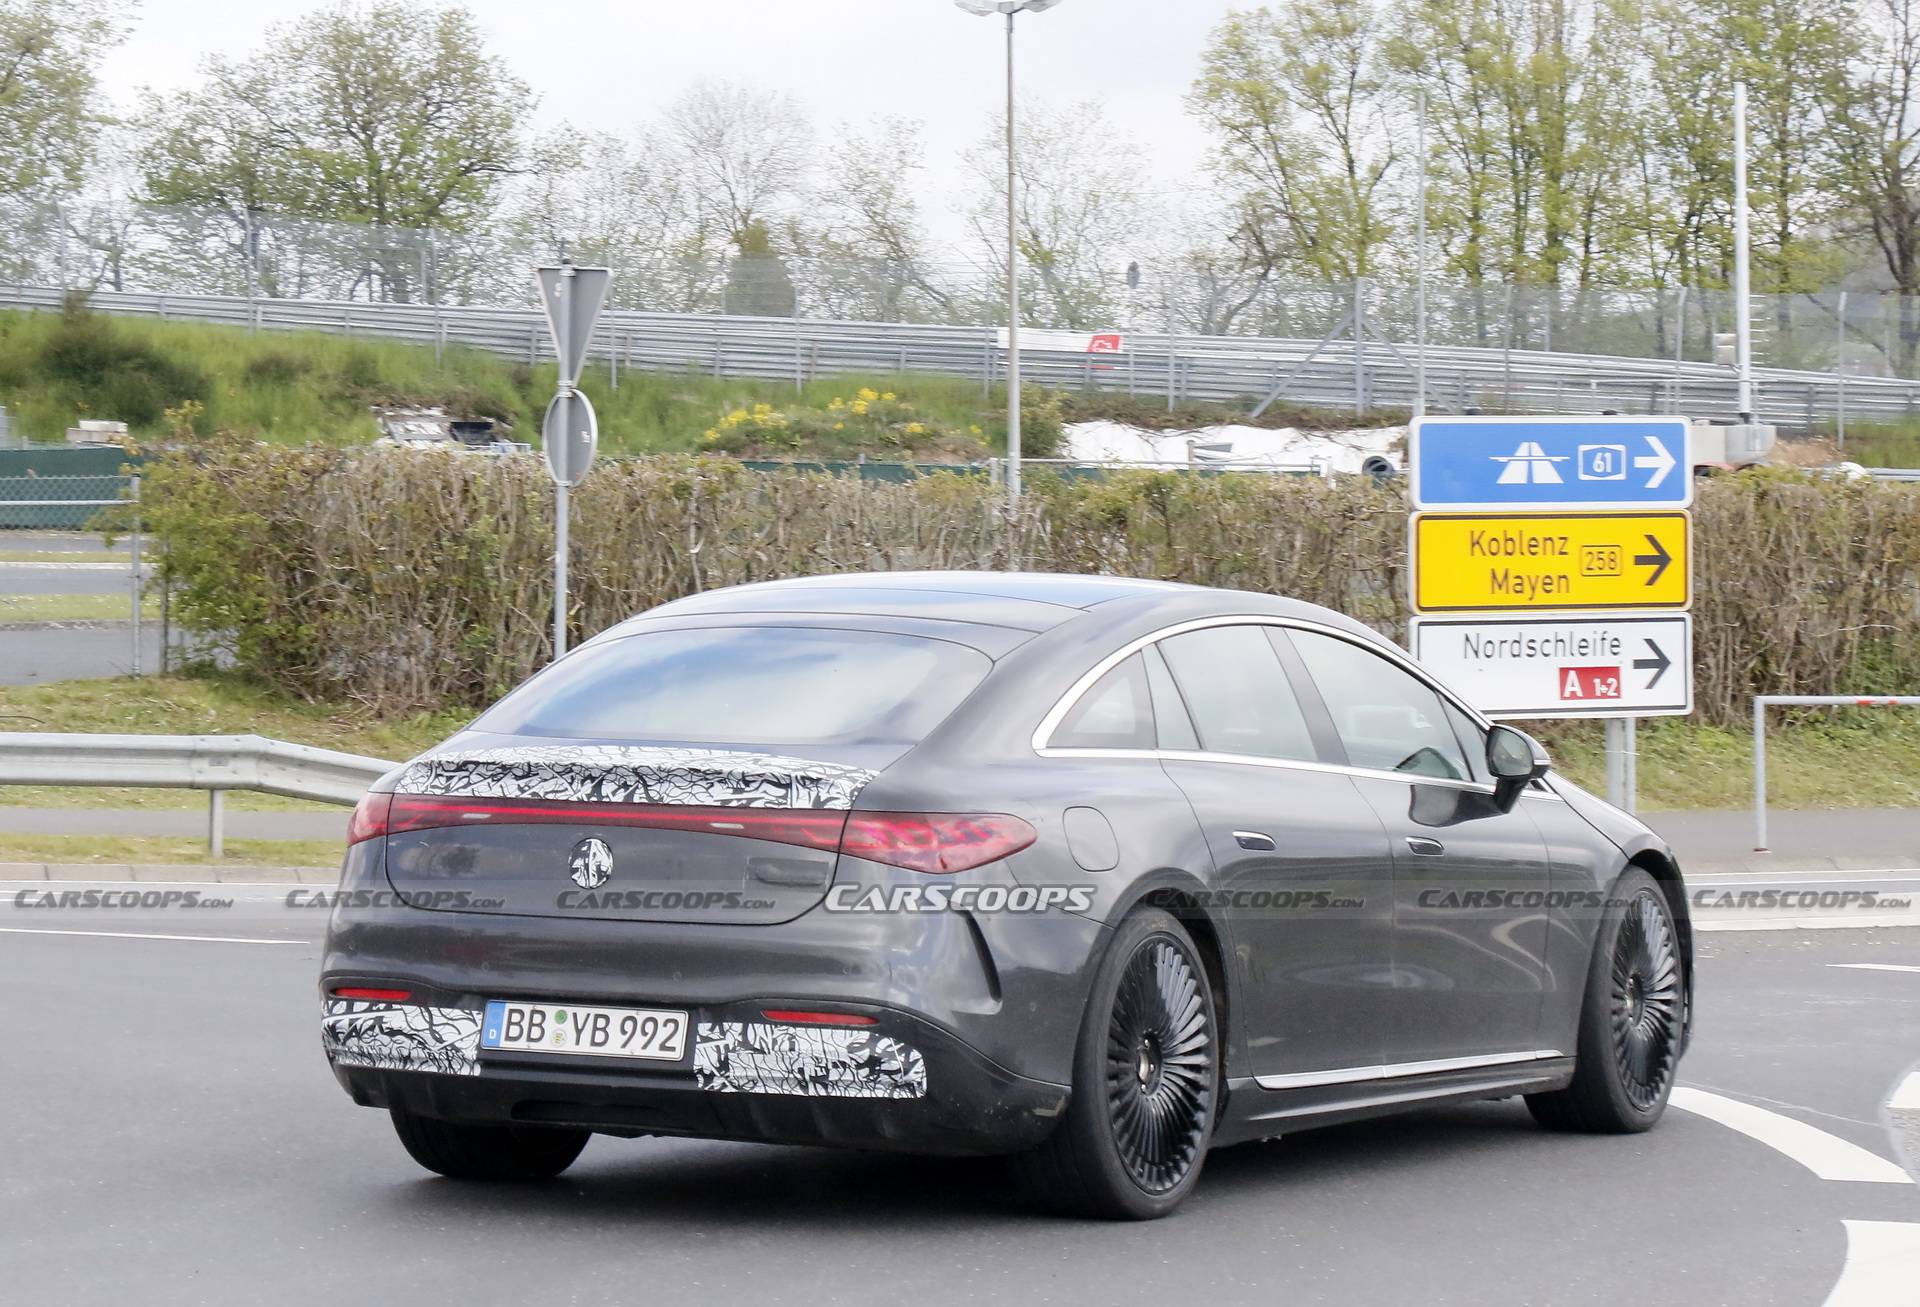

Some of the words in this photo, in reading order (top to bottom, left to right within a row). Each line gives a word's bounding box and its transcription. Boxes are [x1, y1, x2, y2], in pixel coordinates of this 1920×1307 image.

[1592, 452, 1612, 473] 61
[1470, 530, 1569, 557] Koblenz
[1585, 551, 1618, 571] 258
[1490, 568, 1570, 600] Mayen
[1464, 630, 1621, 659] Nordschleife
[1563, 670, 1584, 697] A
[489, 1029, 497, 1040] D
[504, 1008, 547, 1043] BB
[572, 1012, 611, 1047] YB
[619, 1015, 680, 1053] 992
